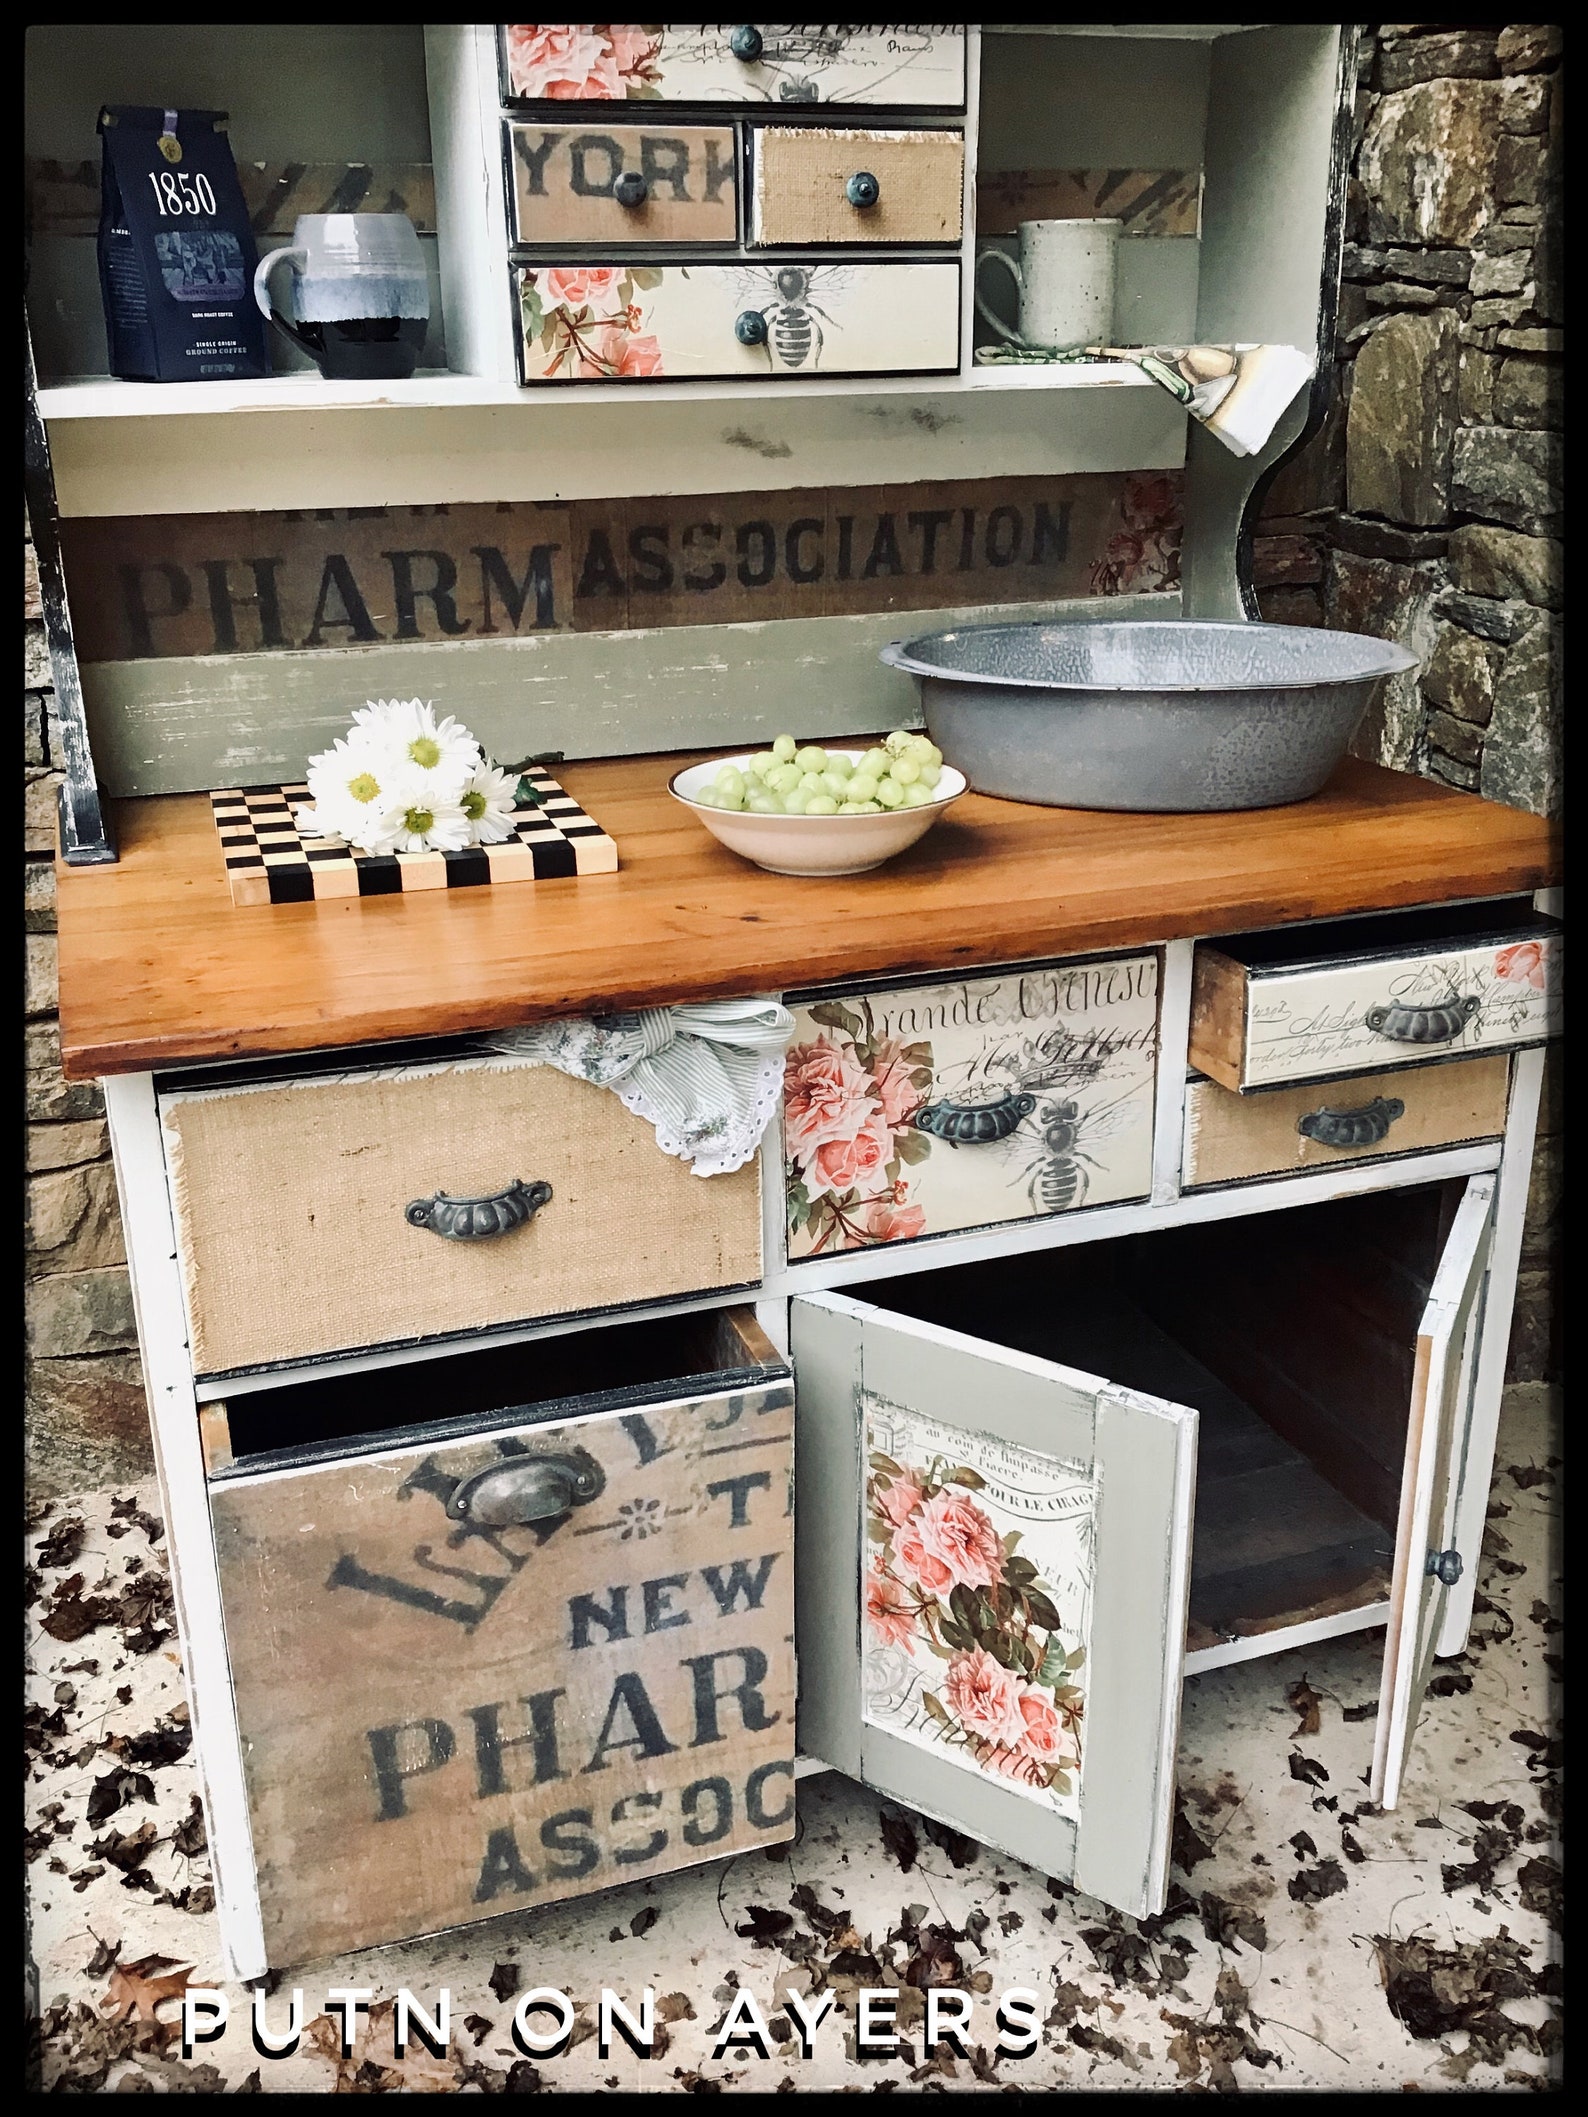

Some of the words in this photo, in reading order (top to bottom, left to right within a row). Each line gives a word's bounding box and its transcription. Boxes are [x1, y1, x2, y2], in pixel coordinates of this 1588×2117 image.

[149, 172, 217, 216] 1850
[185, 348, 217, 356] GROUND
[218, 346, 247, 355] COFFEE
[118, 543, 562, 658] PHARM
[577, 500, 1072, 599] ASSOCIATION
[568, 1551, 781, 1651] NEW
[472, 1761, 795, 1904] ASSOC
